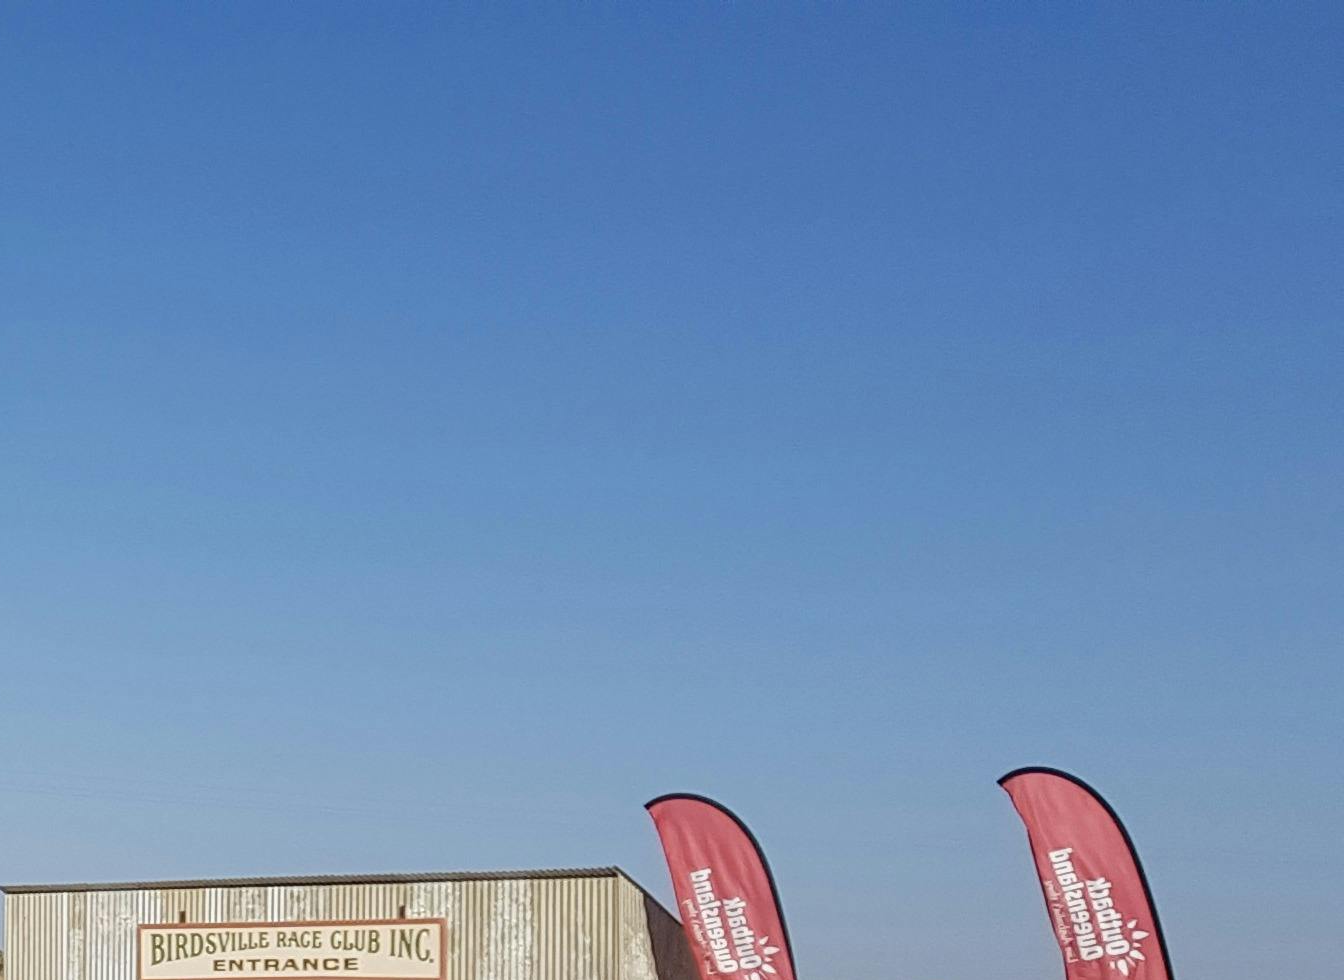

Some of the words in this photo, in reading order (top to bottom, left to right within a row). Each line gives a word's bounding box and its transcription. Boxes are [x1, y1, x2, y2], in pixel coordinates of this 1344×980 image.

[151, 931, 270, 966] BIRDSVILLE
[276, 931, 323, 948] RACE
[331, 930, 381, 953] CLUB
[390, 928, 434, 963] INC.
[213, 958, 359, 972] ENTRANCE
